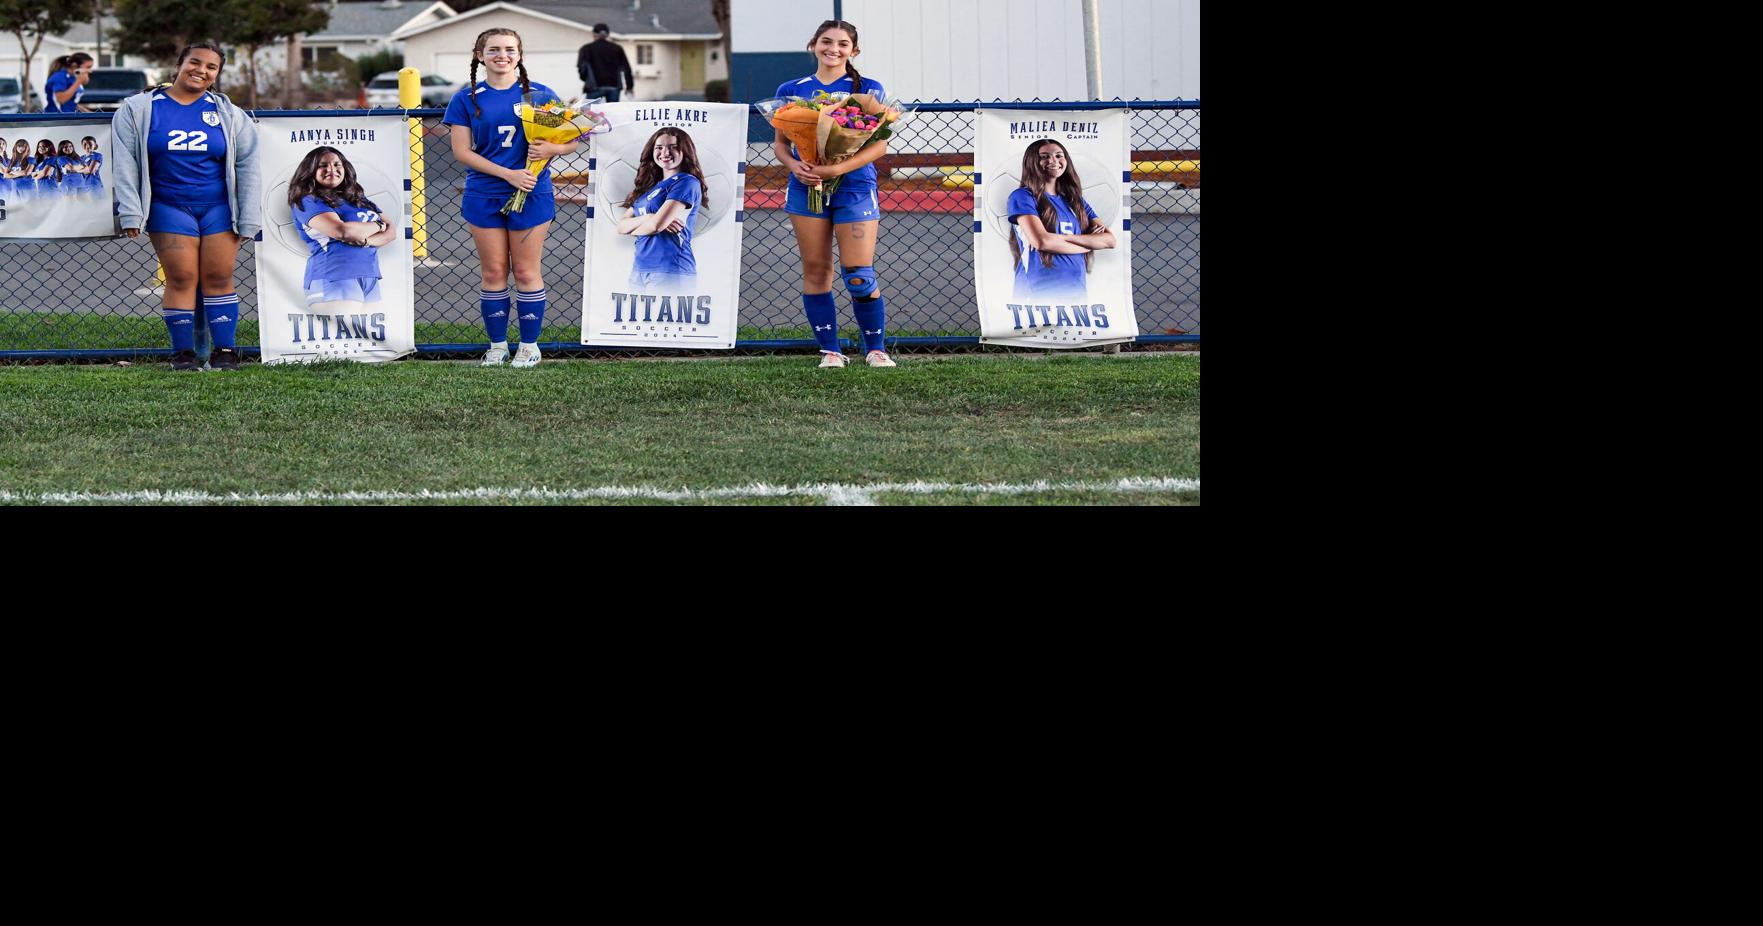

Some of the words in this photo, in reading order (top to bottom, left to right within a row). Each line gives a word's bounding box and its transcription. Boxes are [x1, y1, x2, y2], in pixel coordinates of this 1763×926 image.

[635, 108, 670, 121] ELLIE
[676, 109, 708, 123] AKRE
[291, 129, 331, 143] AANYA
[337, 128, 375, 141] SINGH
[498, 125, 516, 147] 7
[1010, 121, 1056, 134] MALIEA
[1062, 121, 1098, 134] DENIZ
[167, 129, 208, 151] 22
[611, 292, 712, 325] TITANS
[1006, 303, 1110, 330] TITANS
[288, 313, 386, 342] TITANS
